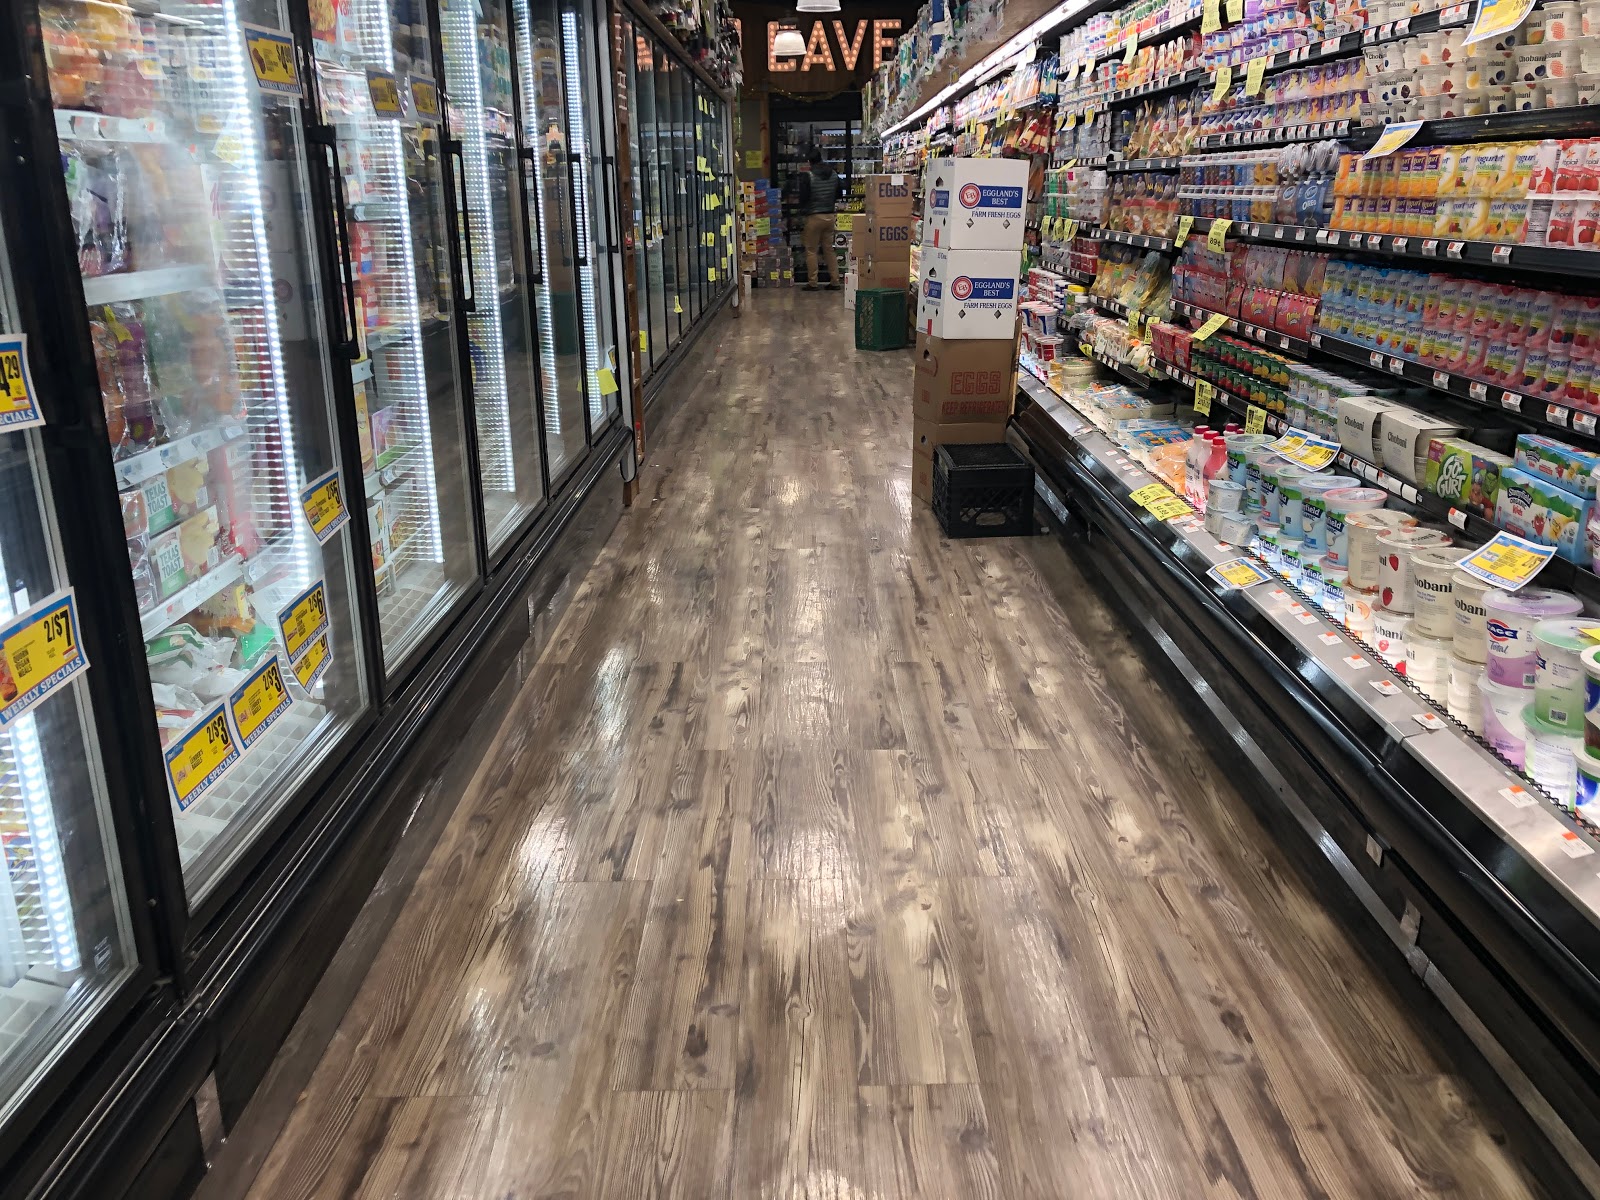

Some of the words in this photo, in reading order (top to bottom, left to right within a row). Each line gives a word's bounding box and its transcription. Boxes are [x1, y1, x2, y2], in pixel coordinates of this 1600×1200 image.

[879, 183, 908, 198] EGGS
[982, 189, 1019, 197] EGGLAND'S
[991, 198, 1008, 206] BEST
[1006, 211, 1021, 219] EGGS
[880, 227, 908, 241] EGGS
[1210, 238, 1221, 247] 89¢
[951, 371, 1001, 395] EGGS
[1344, 416, 1365, 431] Chobani
[1387, 432, 1408, 448] Chobani
[145, 481, 166, 502] TEXAS
[1436, 475, 1467, 498] GURT
[147, 494, 168, 514] TOAST
[160, 545, 179, 568] TEXAS
[161, 557, 181, 579] TOAST
[308, 590, 324, 614] 2/$6
[44, 609, 72, 647] 2/$7
[1489, 640, 1509, 654] Total
[15, 657, 31, 671] VEGAN
[18, 664, 33, 678] MEALS
[2, 687, 41, 720] WEEKLY
[40, 656, 83, 691] SPECIALS
[262, 665, 282, 692] 2/$3
[207, 715, 229, 745] 2/$3
[244, 721, 268, 746] WEEKLY
[267, 698, 291, 725] SPECIALS
[181, 777, 210, 808] WEEKLY
[209, 751, 238, 783] SPECIALS
